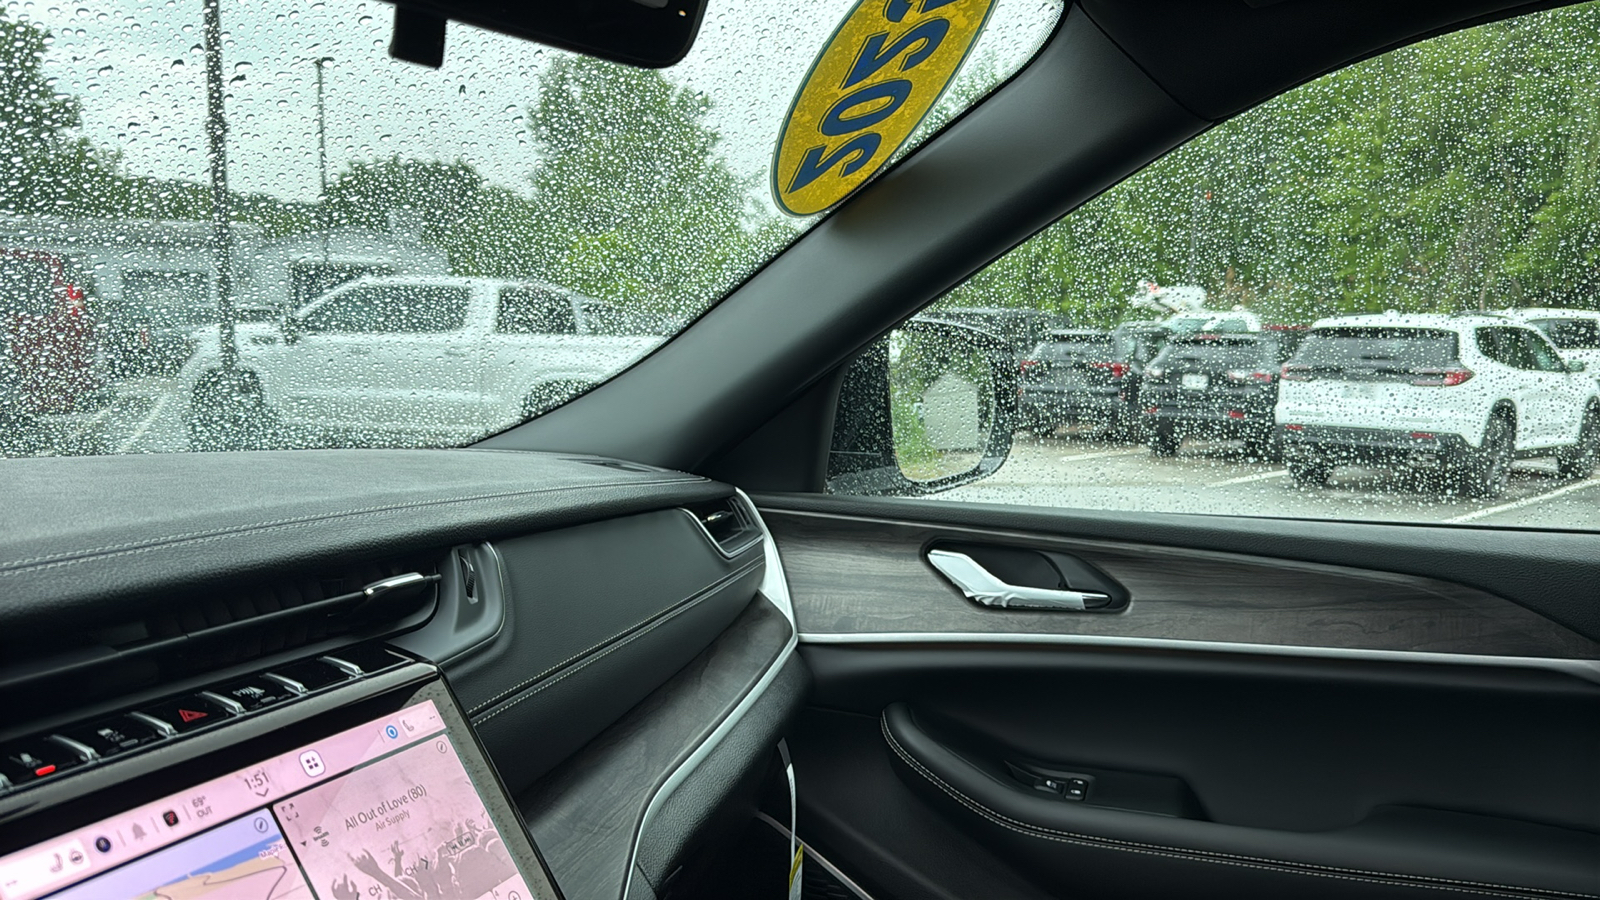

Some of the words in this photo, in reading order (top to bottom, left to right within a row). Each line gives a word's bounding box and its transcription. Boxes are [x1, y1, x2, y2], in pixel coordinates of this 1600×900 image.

[244, 772, 269, 790] 1:51
[196, 806, 213, 818] OUT
[345, 815, 359, 831] All
[357, 808, 378, 824] Out
[377, 801, 387, 815] of
[385, 795, 409, 810] Love
[407, 784, 427, 802] (80)
[375, 820, 387, 832] Air
[385, 809, 410, 826] Supply
[404, 864, 419, 876] CH
[368, 884, 383, 897] CH
